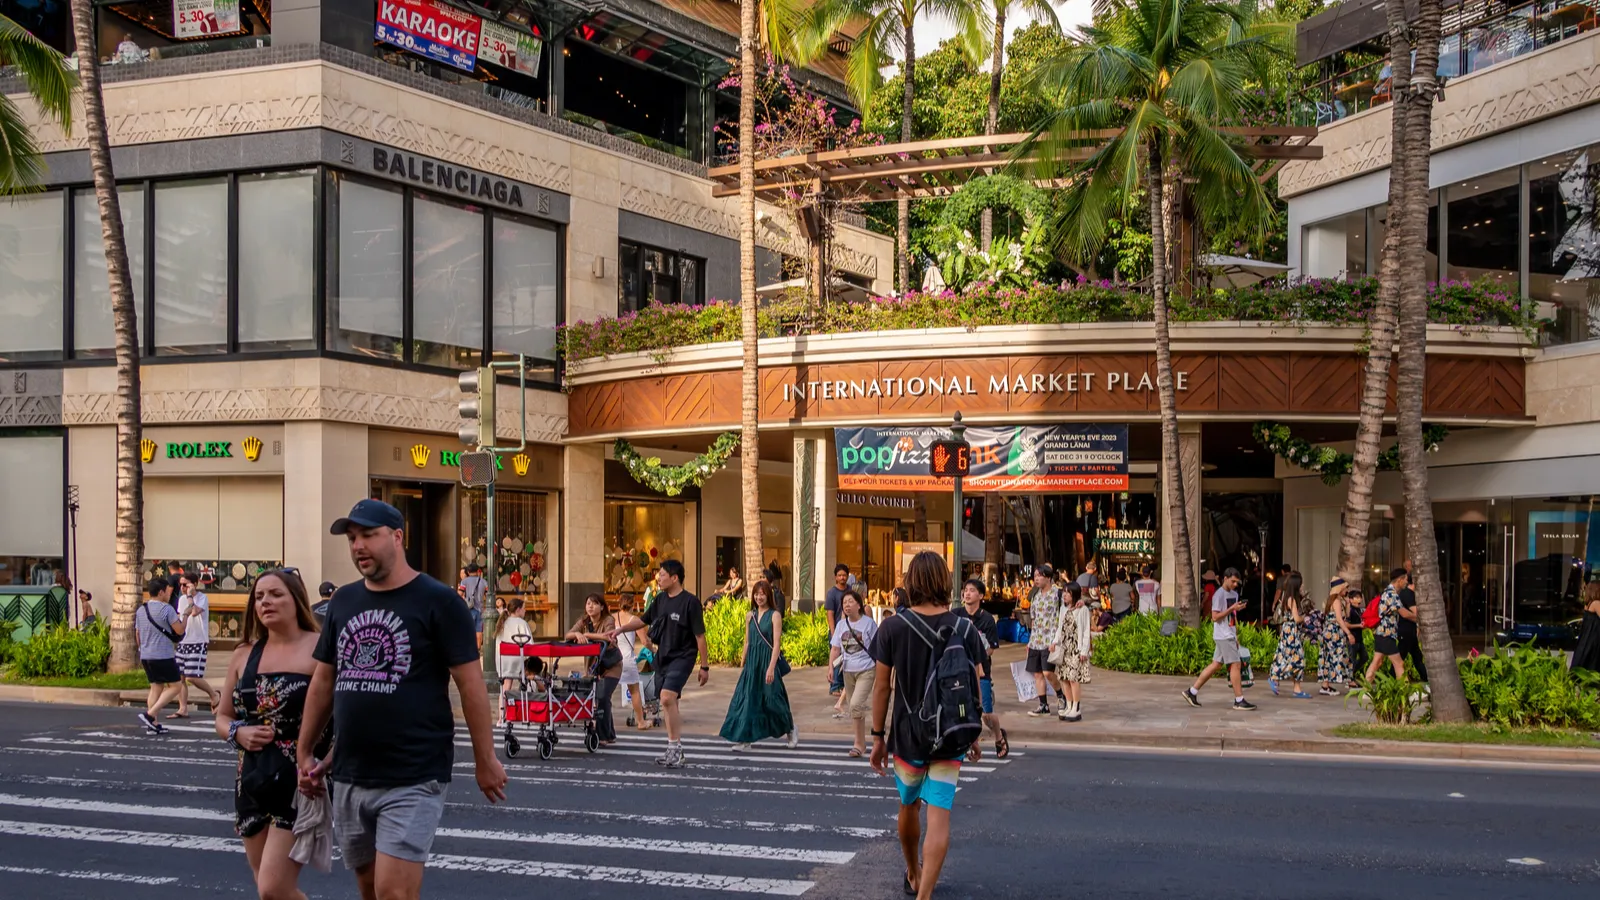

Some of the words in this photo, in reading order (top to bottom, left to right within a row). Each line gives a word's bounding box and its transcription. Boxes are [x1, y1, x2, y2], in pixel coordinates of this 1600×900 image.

[180, 12, 186, 24] 5
[381, 0, 476, 51] KARAOKE
[377, 25, 386, 38] 5
[386, 33, 395, 42] for
[483, 37, 489, 48] 5
[373, 148, 523, 207] BALENCIAGA
[783, 376, 978, 400] INTERNATIONAL
[988, 372, 1096, 394] MARKET
[166, 442, 232, 458] ROLEX
[958, 448, 967, 470] 6
[441, 450, 504, 470] ROX
[969, 478, 1123, 487] SHOPINTERNATIONALMARKETPLACE.COM
[1100, 540, 1140, 550] MARKET
[1143, 541, 1155, 550] PL
[343, 642, 355, 660] THE
[354, 628, 393, 662] EXCELLENCE
[348, 609, 403, 634] HITMAN
[393, 629, 412, 675] HART
[361, 681, 397, 694] CHAMP
